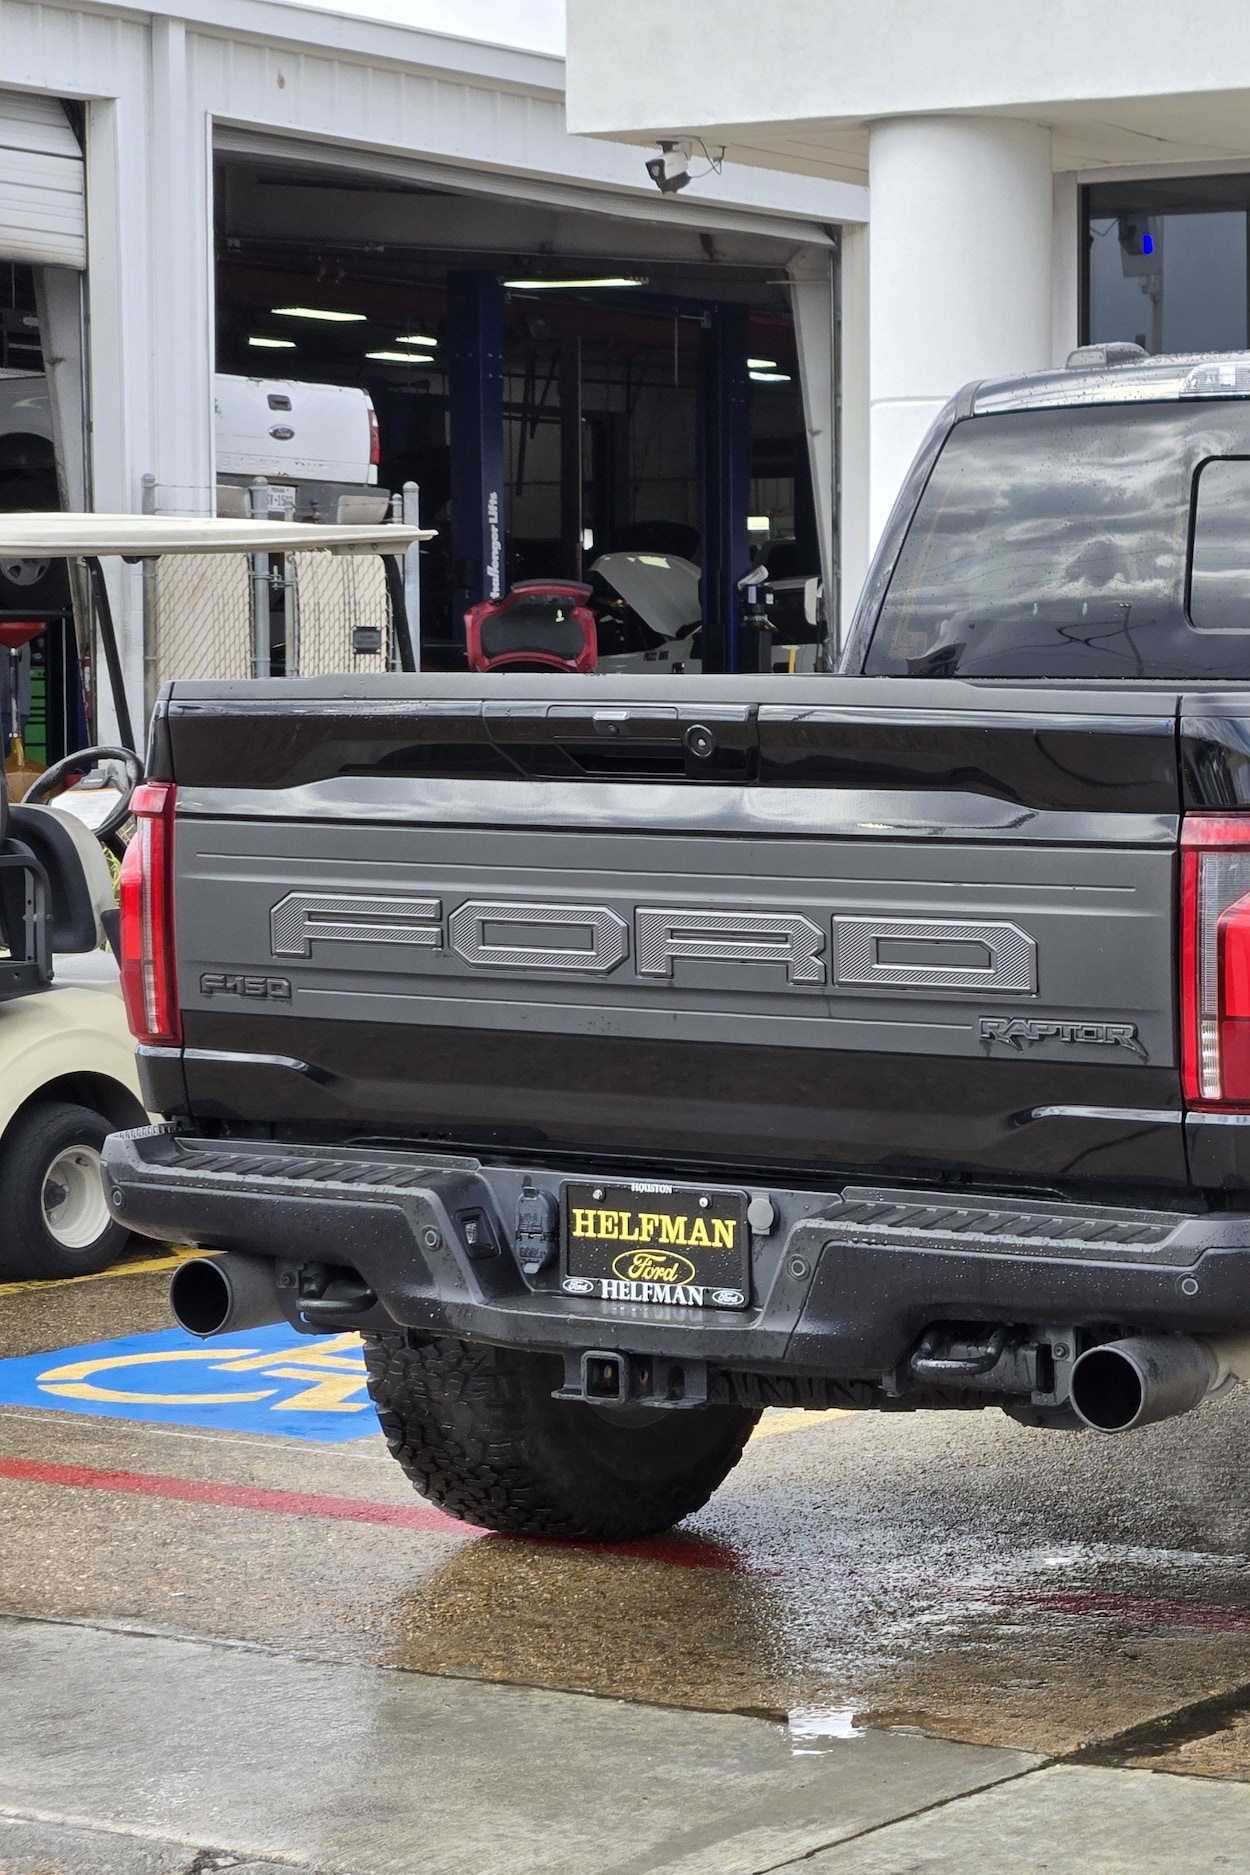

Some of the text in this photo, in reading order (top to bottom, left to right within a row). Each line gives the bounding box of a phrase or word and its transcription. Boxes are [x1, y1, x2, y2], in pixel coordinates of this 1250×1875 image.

[487, 491, 501, 599] hallenger Lifts
[270, 890, 1039, 997] FORD
[978, 1016, 1150, 1060] RAPTOR
[631, 1182, 673, 1194] HOUSTON
[572, 1208, 737, 1249] HELFMAN
[628, 1252, 679, 1283] Ford
[601, 1278, 704, 1306] HELFMAN
